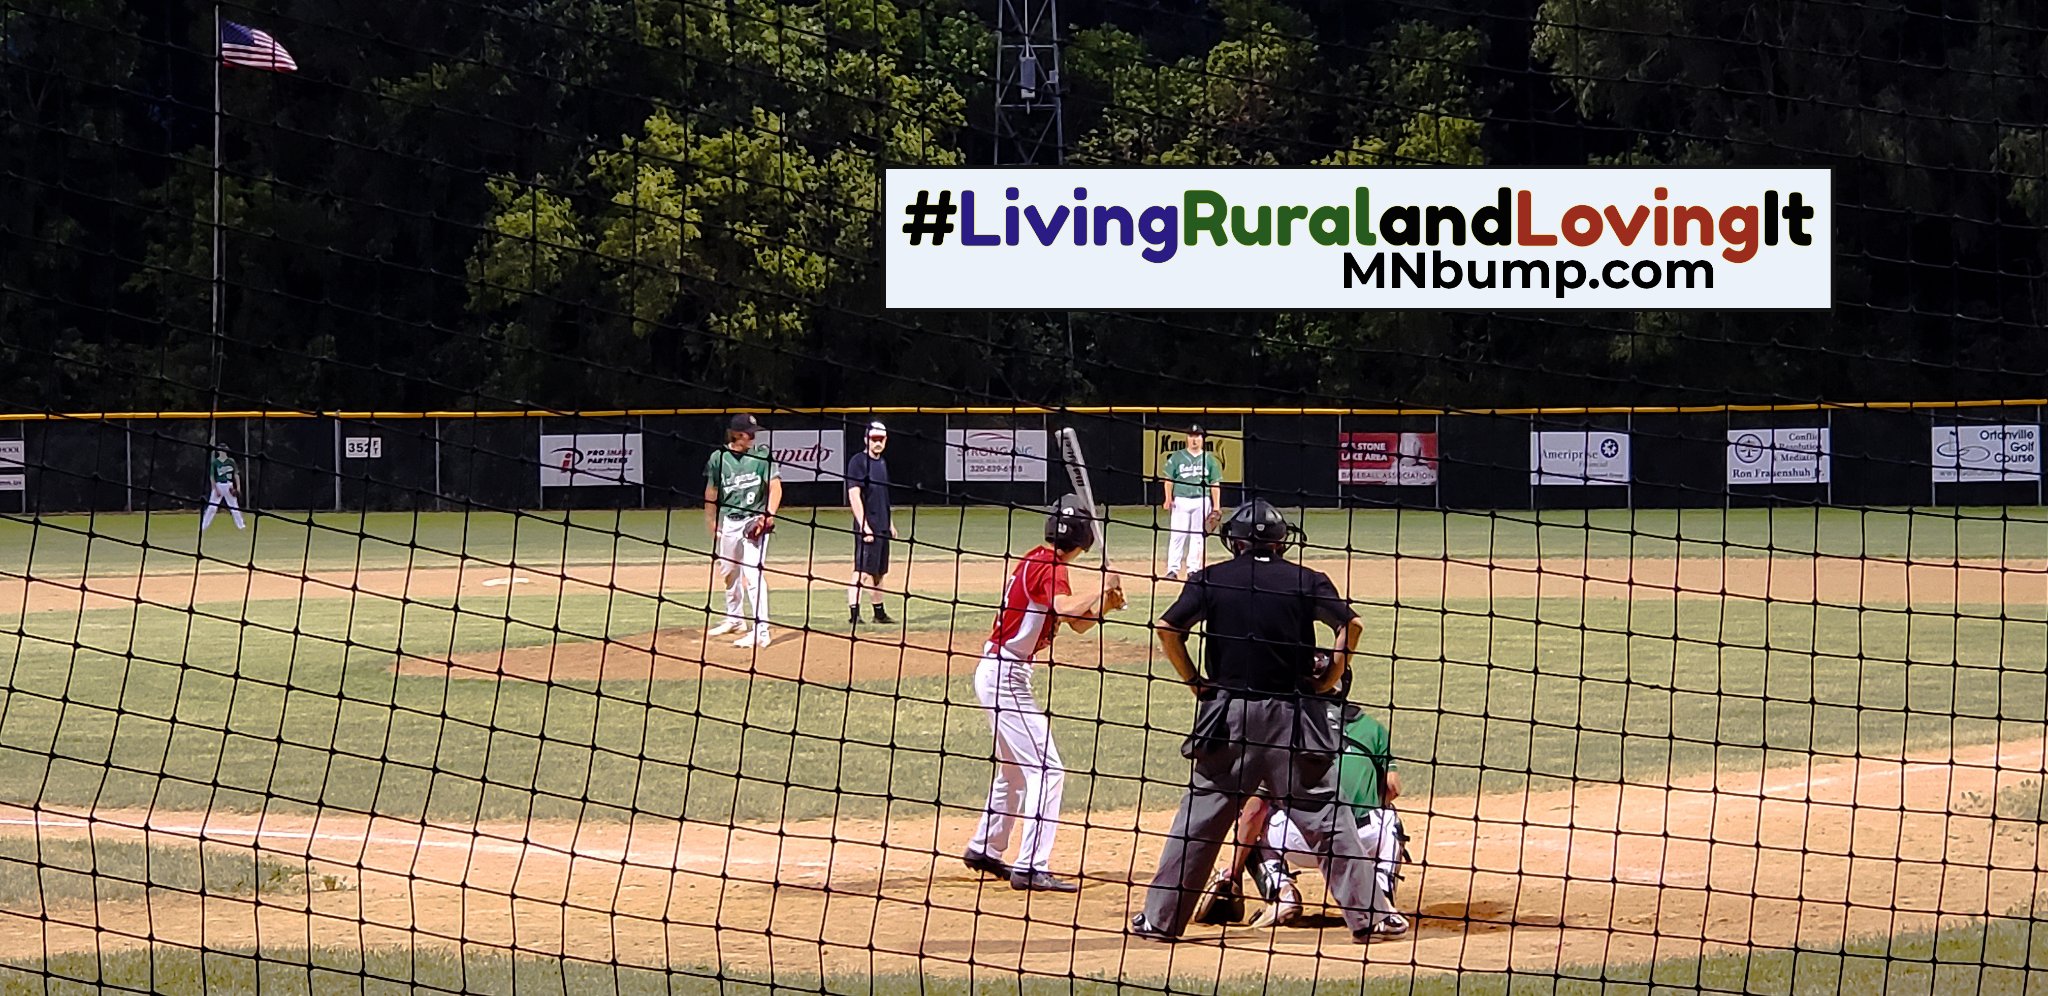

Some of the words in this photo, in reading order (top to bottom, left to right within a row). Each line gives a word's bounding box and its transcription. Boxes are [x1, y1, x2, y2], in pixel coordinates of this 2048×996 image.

[1980, 430, 2034, 440] Ortonville
[1357, 443, 1386, 451] STONE
[2010, 442, 2035, 452] Golf
[758, 443, 834, 468] aputo
[1541, 449, 1598, 461] Ameripre
[1994, 453, 2035, 462] Course
[1733, 469, 1752, 478] Ron
[746, 491, 756, 505] 8
